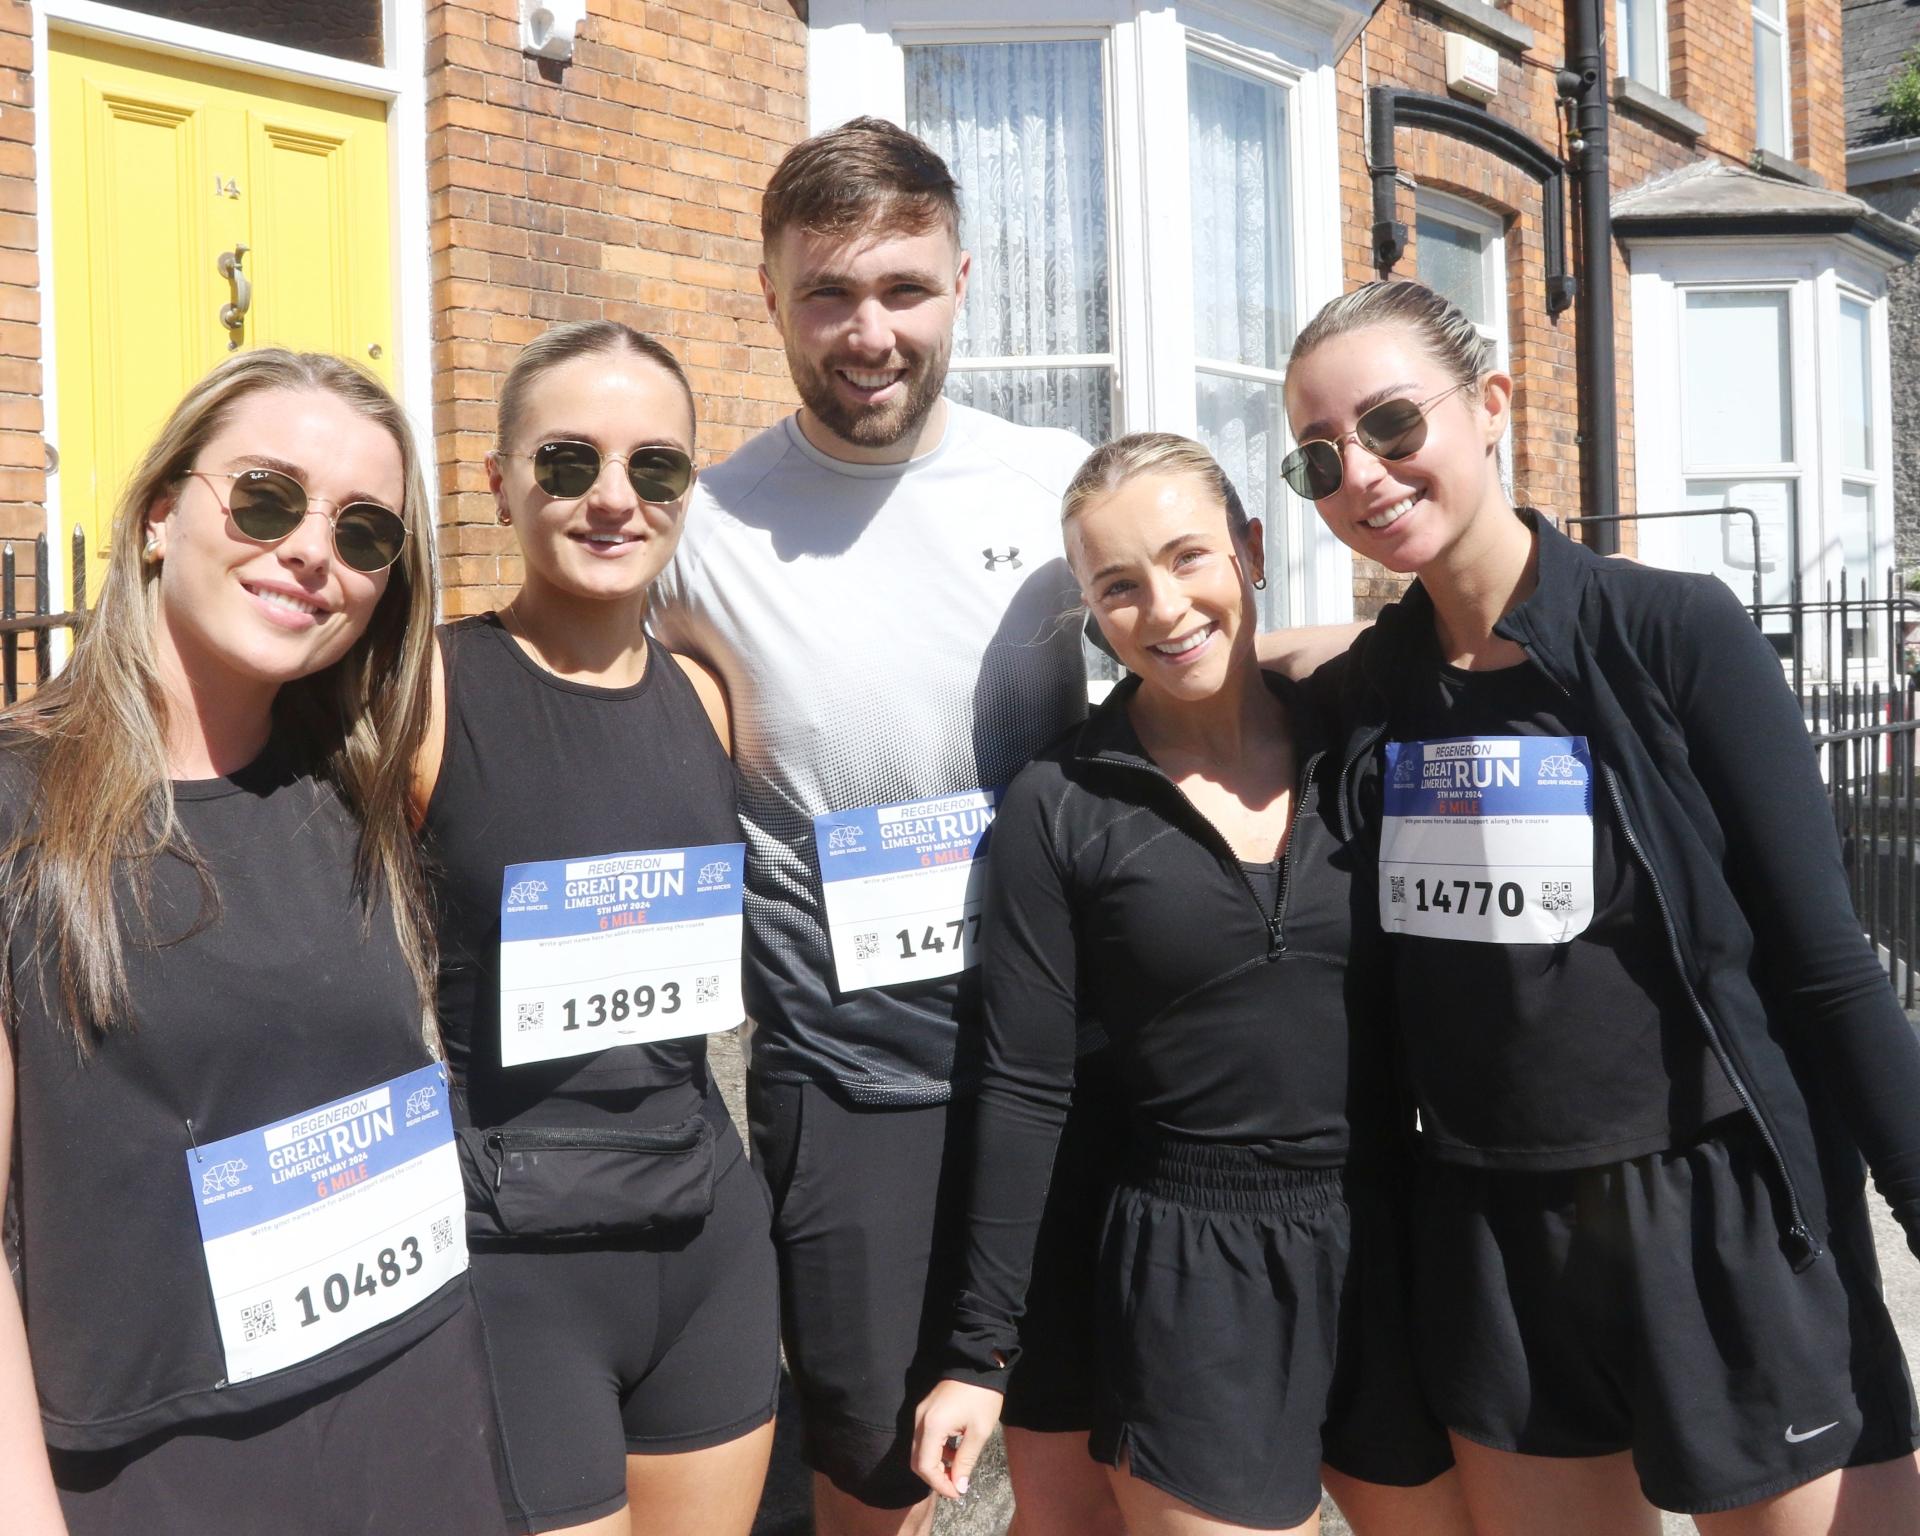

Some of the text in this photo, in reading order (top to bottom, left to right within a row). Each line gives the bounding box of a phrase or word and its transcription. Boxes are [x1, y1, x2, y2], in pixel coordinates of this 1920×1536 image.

[214, 175, 241, 200] 14
[1435, 744, 1492, 759] REGENERON
[1422, 761, 1454, 778] GREAT
[1454, 759, 1520, 788] RUN
[1420, 778, 1453, 790] LIMERICK
[1437, 789, 1483, 799] 5TH MAY 2024
[900, 798, 975, 819] REGENERON
[1439, 800, 1479, 815] 6 MILE
[880, 817, 935, 840] GREAT
[936, 807, 997, 841] RUN
[1468, 818, 1489, 826] support
[1490, 817, 1510, 826] along
[881, 832, 937, 850] LIMERICK
[915, 838, 972, 854] 5TH MAY 2024
[588, 857, 662, 876] REGENERON
[921, 853, 931, 867] 6
[934, 847, 970, 864] MILE
[565, 876, 616, 898] GREAT
[616, 869, 685, 901] RUN
[564, 892, 617, 910] LIMERICK
[596, 900, 651, 916] 5TH MAY 2024
[1415, 879, 1525, 918] 14770
[599, 910, 647, 930] 6 MILE
[896, 912, 982, 959] 1477
[561, 981, 682, 1032] 13893
[291, 1098, 369, 1140] REGENERON
[328, 1106, 395, 1160] RUN
[268, 1132, 329, 1170] GREAT
[271, 1150, 332, 1185] LIMERICK
[311, 1151, 369, 1183] 5TH MAY 2024
[316, 1162, 369, 1199] 6 MILE
[251, 1225, 272, 1237] Write
[379, 1171, 395, 1184] along
[294, 1236, 423, 1328] 10483
